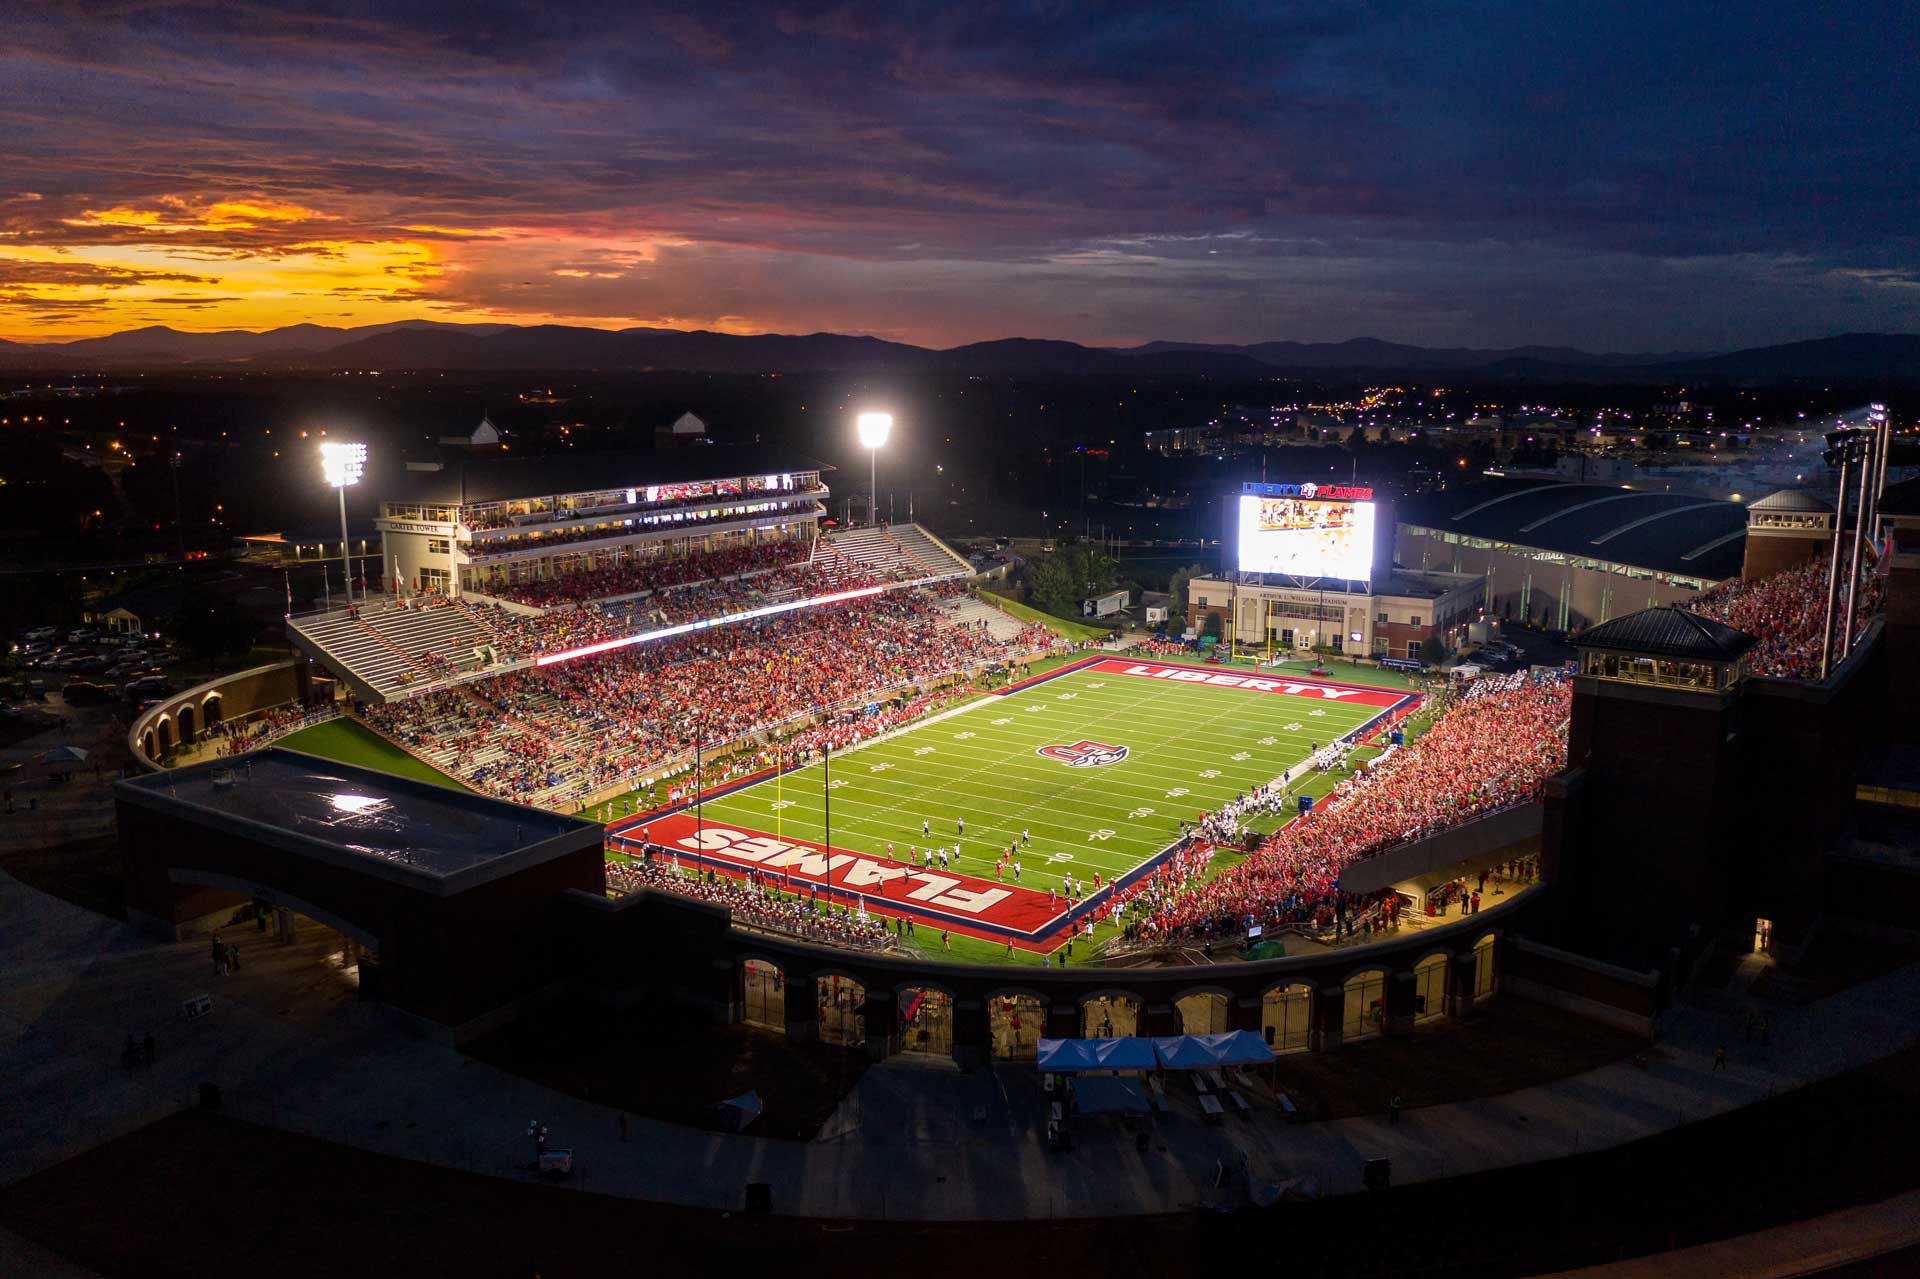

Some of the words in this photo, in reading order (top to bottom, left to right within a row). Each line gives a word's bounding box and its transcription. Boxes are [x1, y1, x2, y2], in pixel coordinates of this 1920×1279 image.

[1242, 481, 1301, 496] LIBERTY
[1316, 485, 1373, 500] FLAMES
[416, 524, 439, 532] TOWER
[1123, 665, 1361, 699] LIBERTY
[1128, 807, 1154, 818] 30
[1087, 829, 1116, 841] 20
[1045, 853, 1073, 865] 10
[676, 828, 1014, 913] FLAMES
